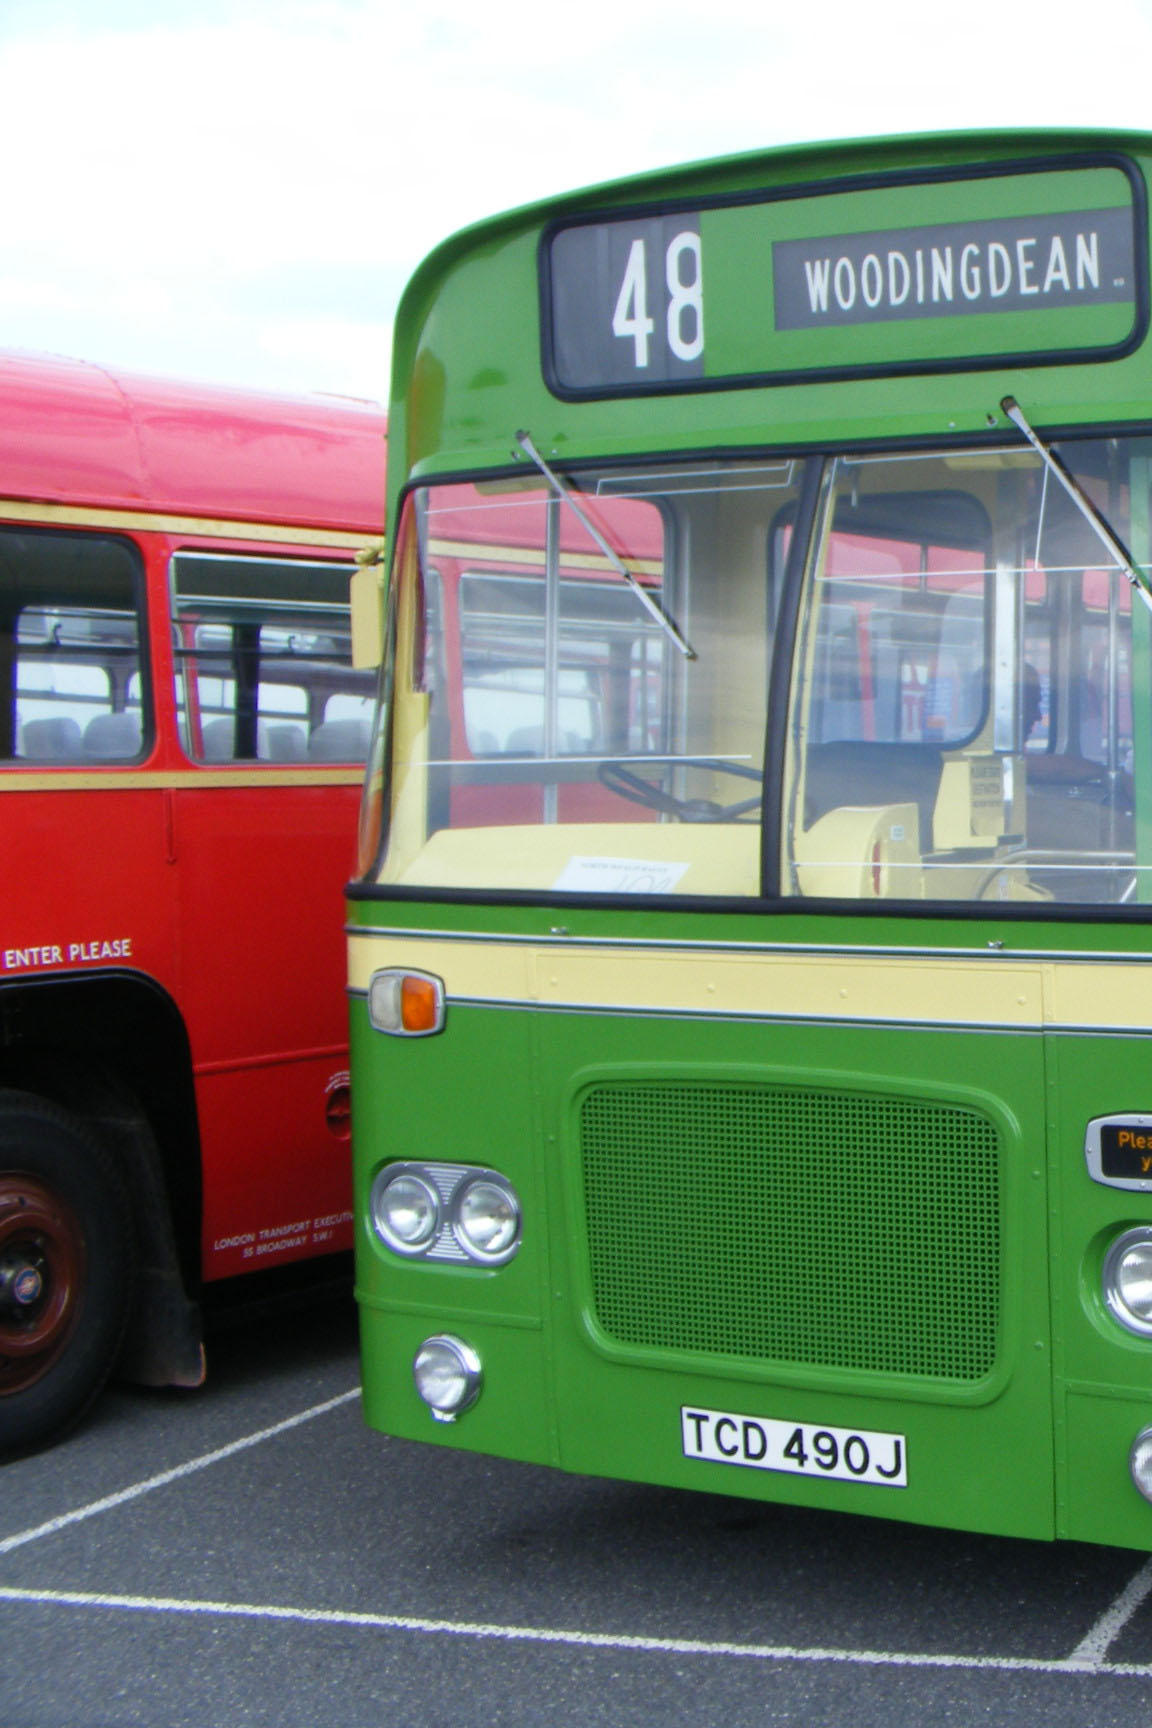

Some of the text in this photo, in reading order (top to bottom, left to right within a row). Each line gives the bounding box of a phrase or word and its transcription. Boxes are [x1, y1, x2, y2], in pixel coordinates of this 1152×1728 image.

[804, 232, 1100, 313] WOODINGDEAN
[612, 231, 703, 368] 48
[5, 939, 132, 968] ENTER PLEASE
[214, 1233, 256, 1251] LONDON
[259, 1220, 311, 1240] TRANSPORT
[256, 1235, 308, 1256] BROADWAY
[686, 1412, 902, 1478] TCD 490J
